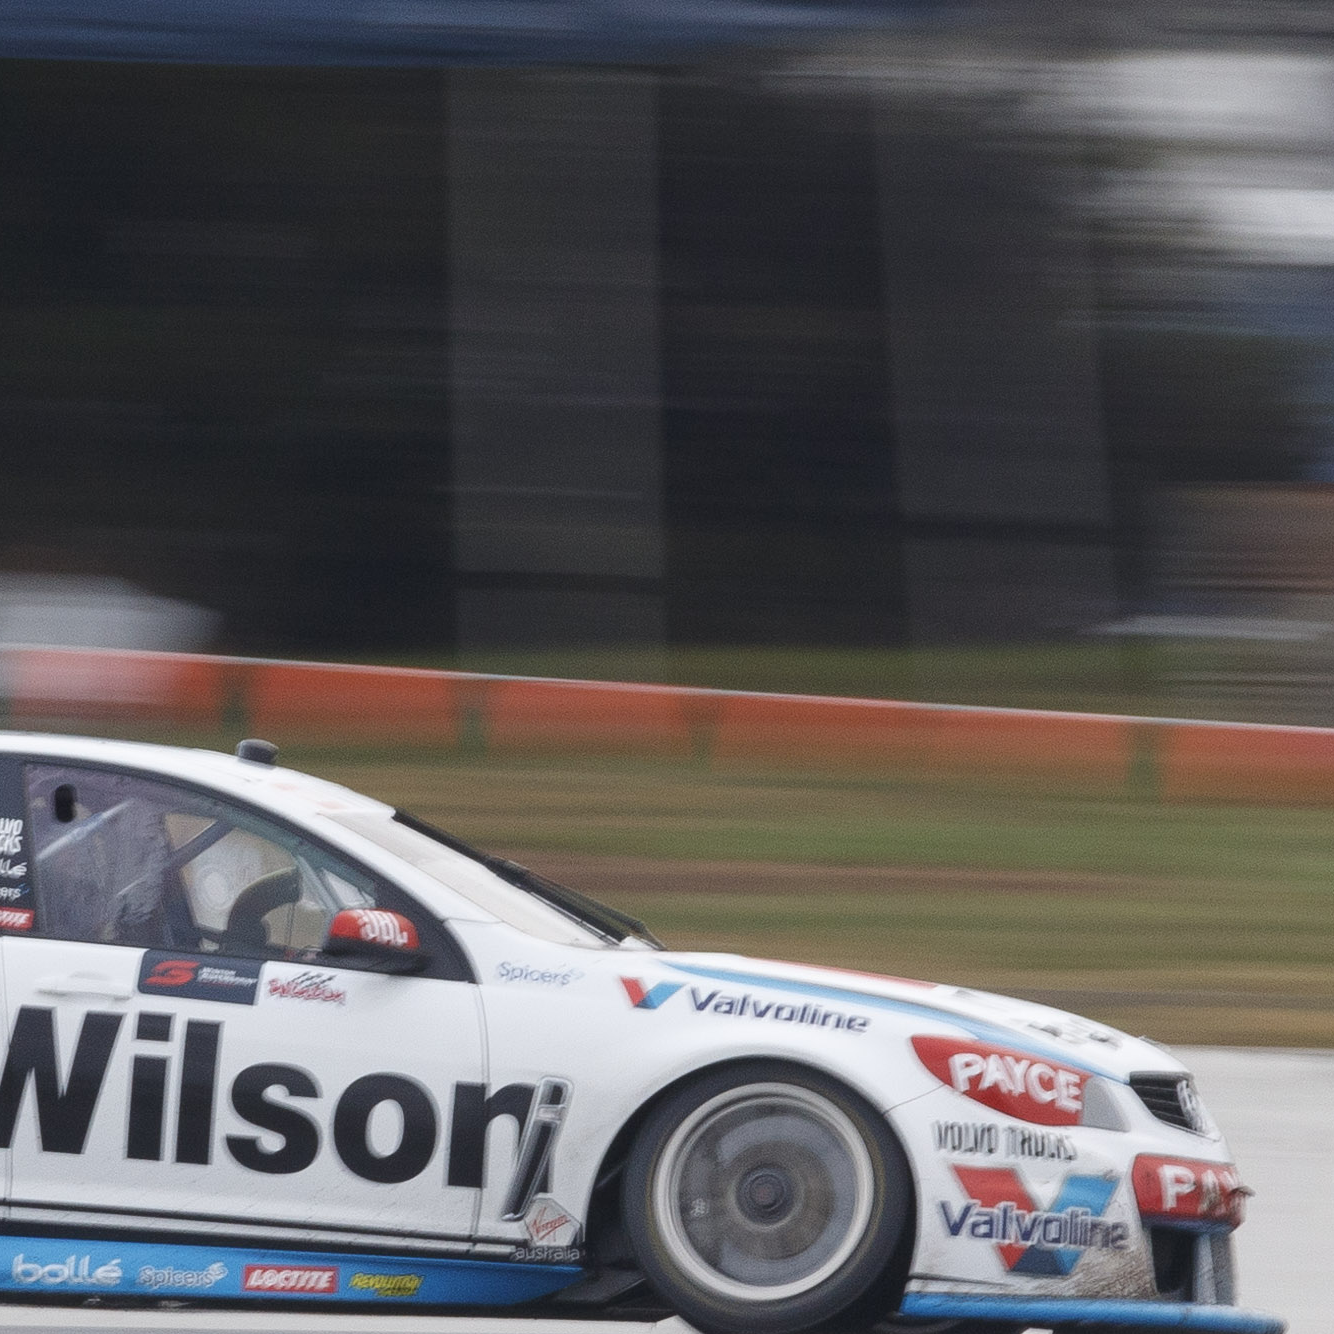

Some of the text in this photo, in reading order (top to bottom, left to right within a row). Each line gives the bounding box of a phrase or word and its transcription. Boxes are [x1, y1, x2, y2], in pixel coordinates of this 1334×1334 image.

[498, 961, 573, 985] Spicers
[689, 987, 872, 1034] Valvoline
[948, 1053, 1084, 1113] PAYCE
[933, 1121, 1077, 1161] VOLVO TRUCKS
[938, 1199, 1131, 1250] Valvoline
[138, 1265, 213, 1290] Spicers
[244, 1269, 335, 1289] LOCTITE
